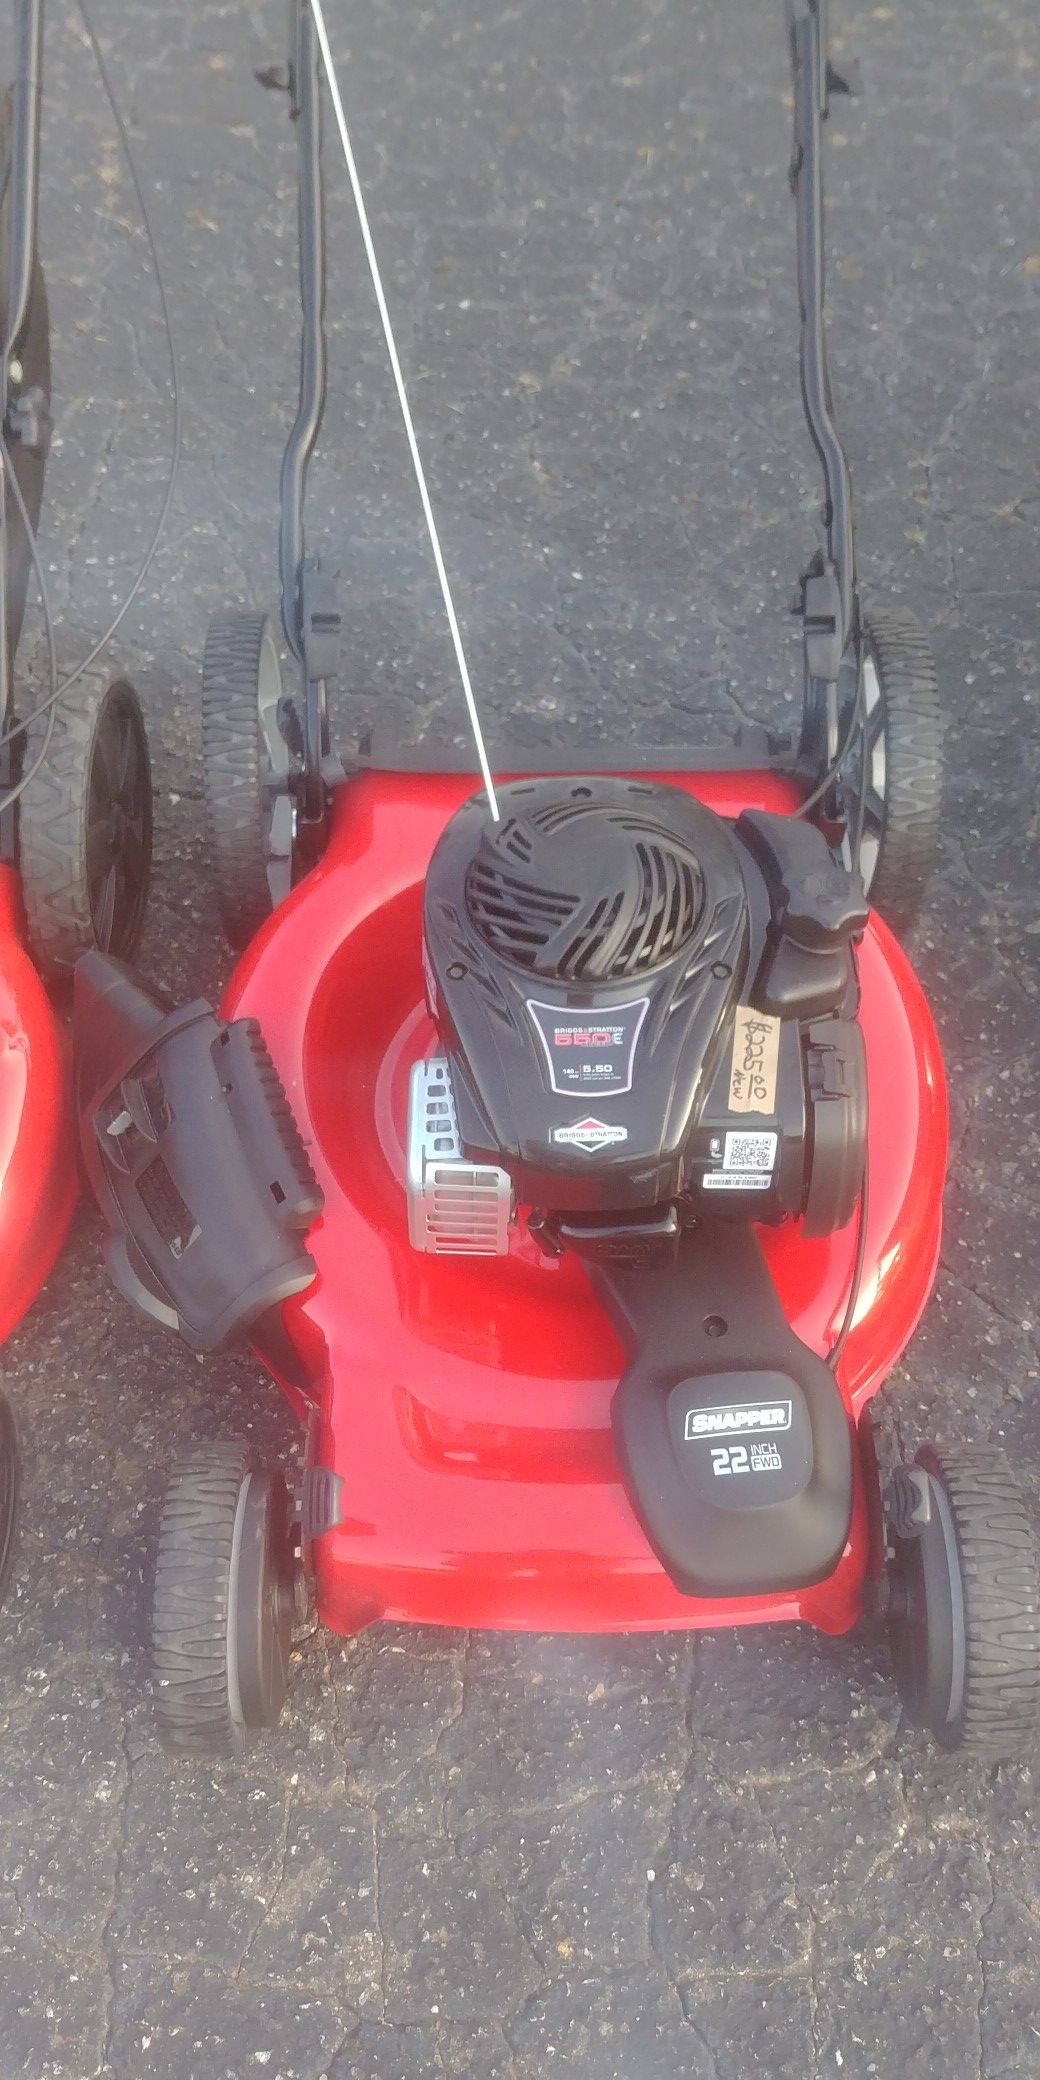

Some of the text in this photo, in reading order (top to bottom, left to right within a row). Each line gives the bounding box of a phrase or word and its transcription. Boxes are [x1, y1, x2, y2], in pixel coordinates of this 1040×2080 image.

[691, 1408, 786, 1433] SNAPPER
[710, 1442, 778, 1476] 22 INCH
[752, 1456, 781, 1470] FWD
